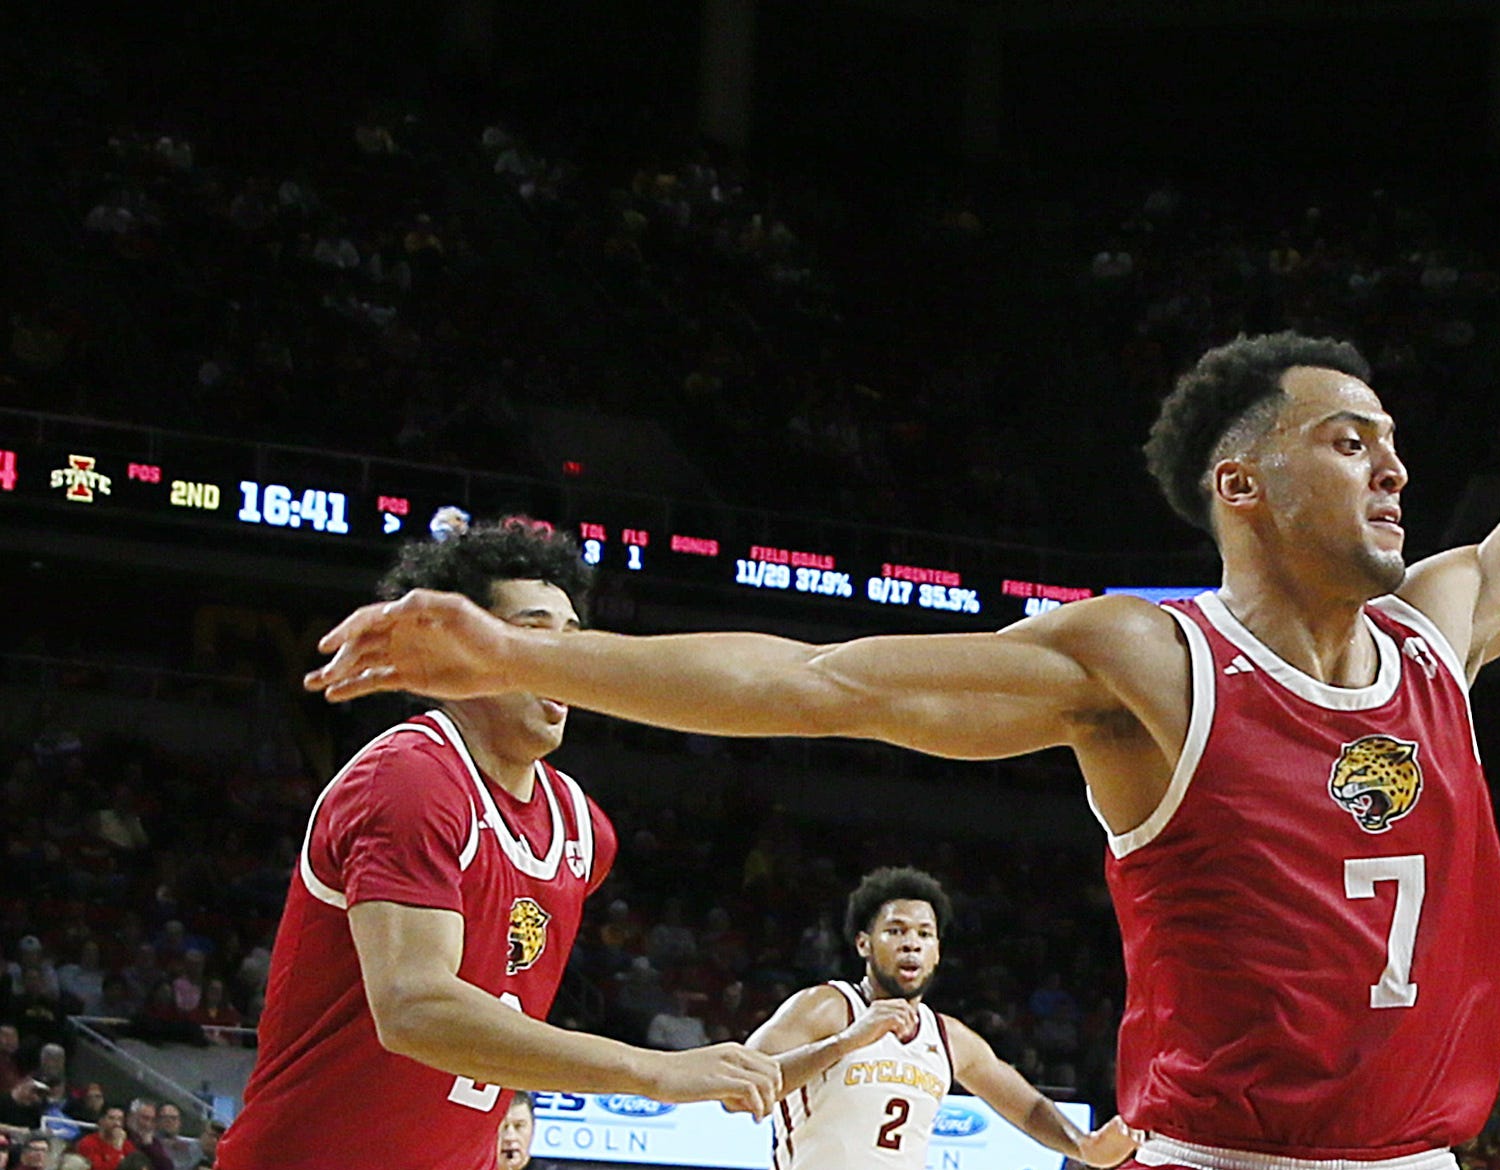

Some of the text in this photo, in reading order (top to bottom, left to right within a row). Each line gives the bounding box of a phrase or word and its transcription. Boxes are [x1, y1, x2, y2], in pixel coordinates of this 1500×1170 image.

[127, 462, 162, 484] POS
[170, 480, 349, 534] 2ND 16:41
[627, 544, 642, 570] 1
[751, 545, 835, 571] FIELD GOALS
[735, 558, 791, 589] 11/29
[894, 564, 961, 587] POINTERS
[867, 577, 913, 604] 6/17
[1002, 579, 1033, 597] FREE
[1343, 854, 1425, 1009] 7
[876, 1097, 911, 1151] 2
